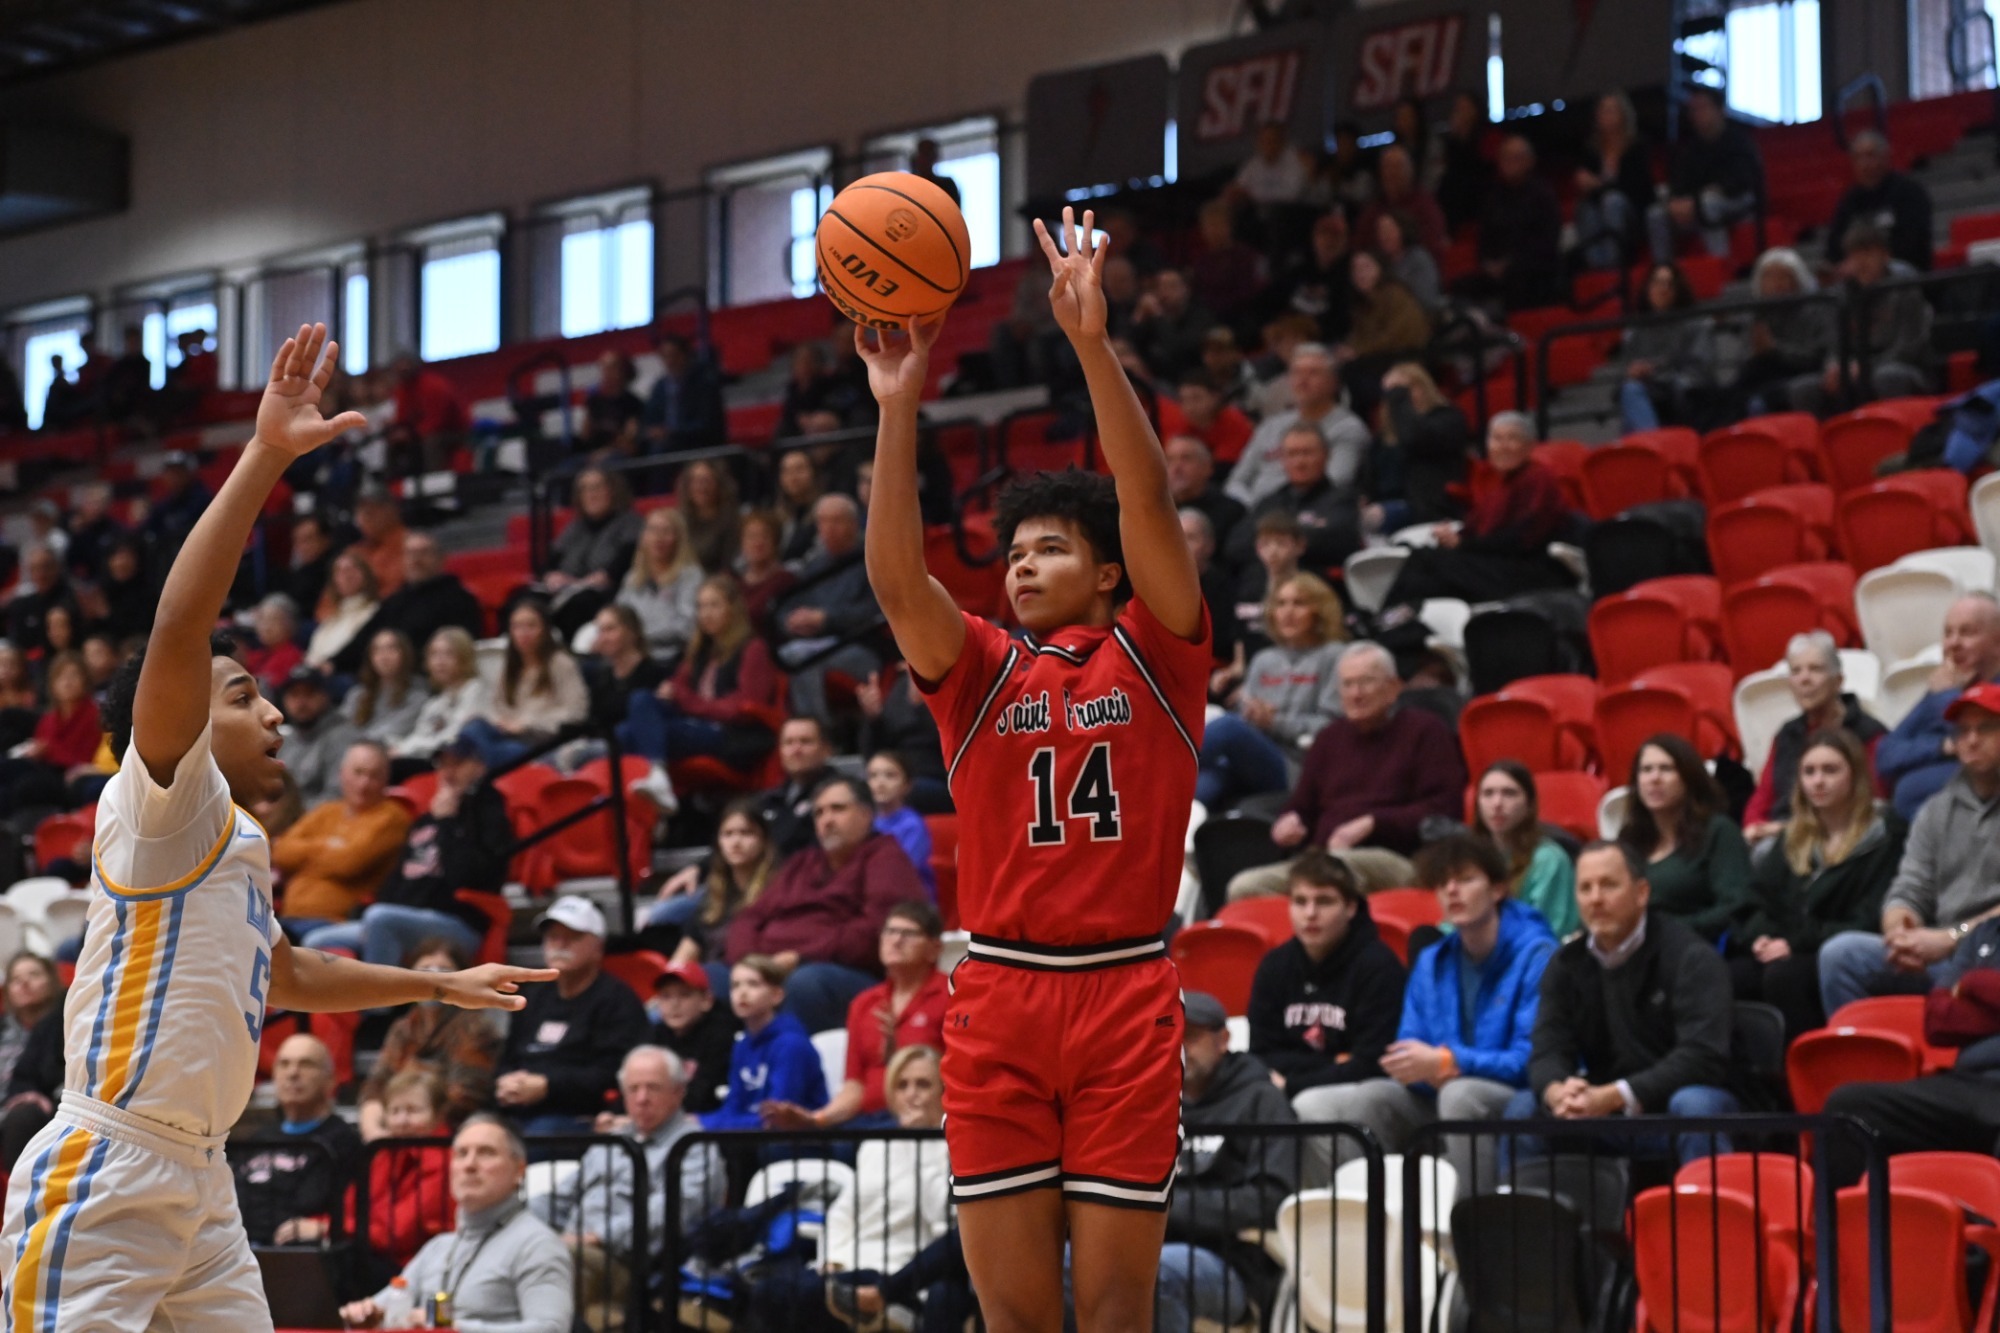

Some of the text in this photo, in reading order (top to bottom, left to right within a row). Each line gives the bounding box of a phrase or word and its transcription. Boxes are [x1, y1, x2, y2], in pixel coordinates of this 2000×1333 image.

[1198, 52, 1298, 138] SFU
[1355, 16, 1460, 105] SFU
[841, 253, 900, 298] EVO
[1028, 741, 1122, 847] 14
[245, 946, 271, 1043] 5
